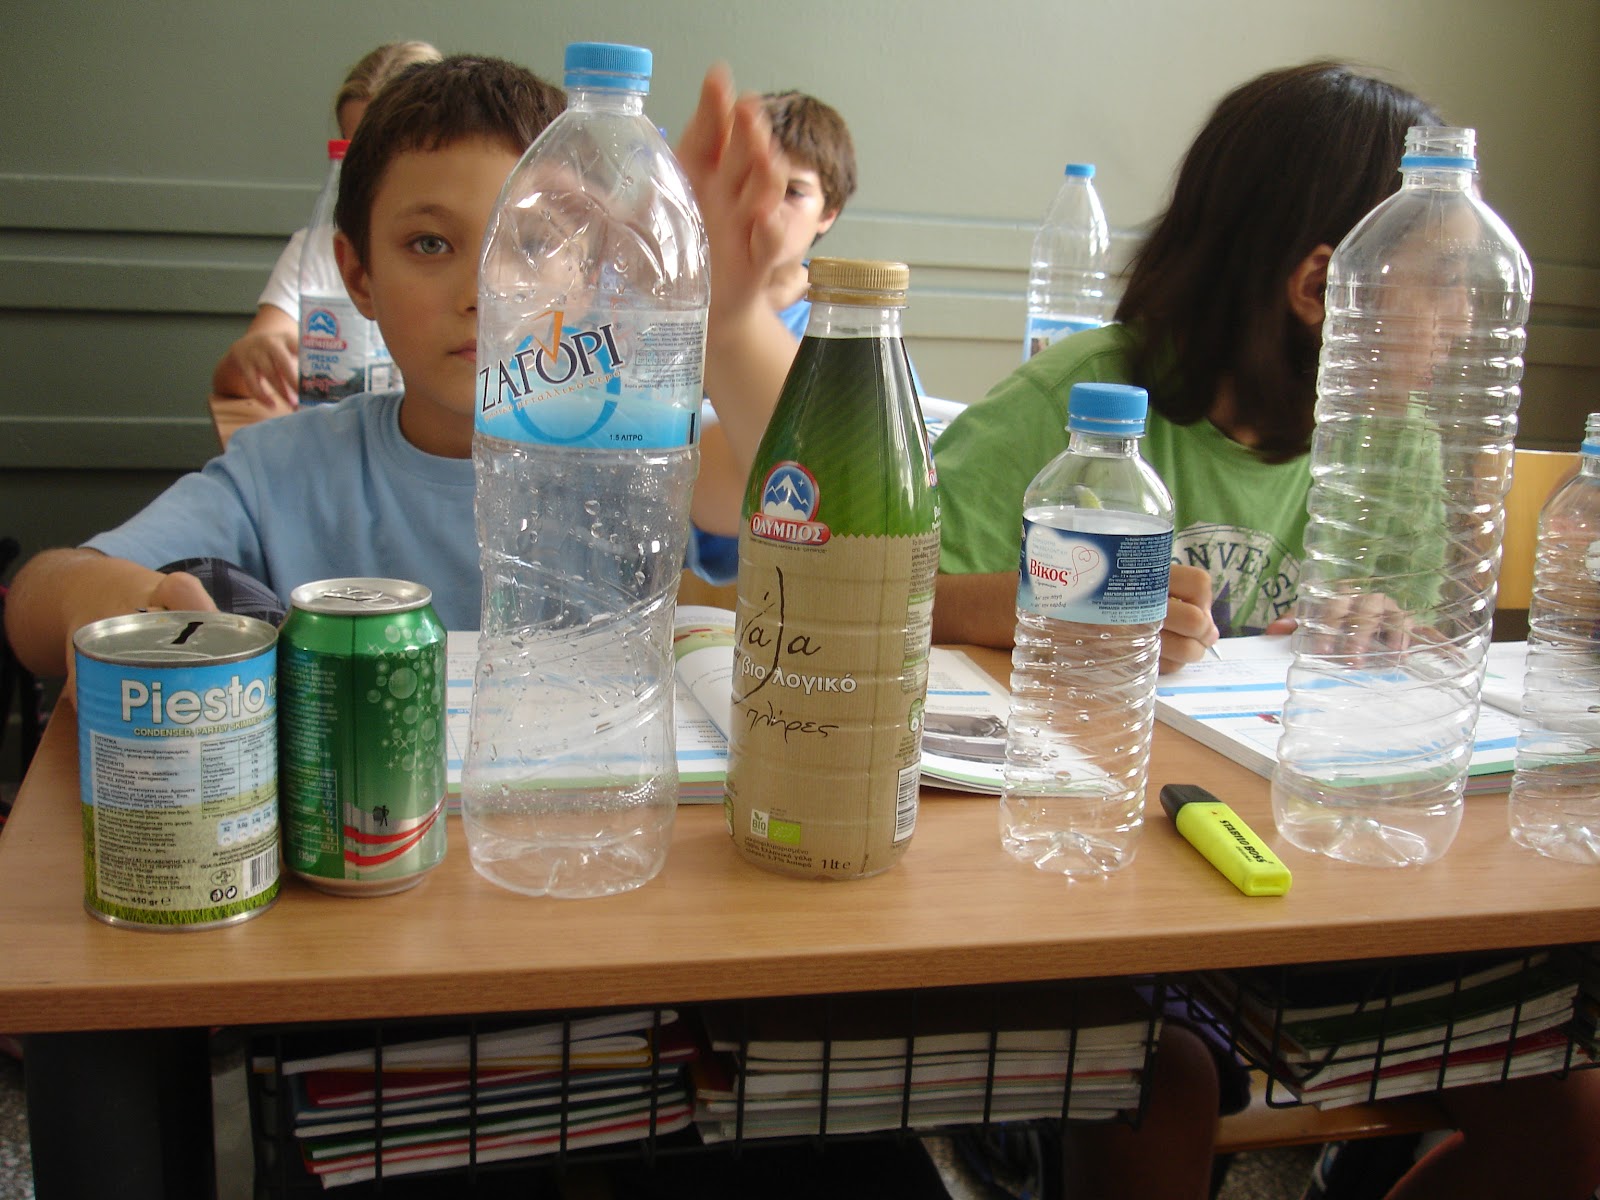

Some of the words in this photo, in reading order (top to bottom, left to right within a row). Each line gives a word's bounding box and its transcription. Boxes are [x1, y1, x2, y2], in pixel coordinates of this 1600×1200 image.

[752, 515, 825, 543] ΟΛΥΜΠΟΣ
[1029, 558, 1068, 587] Βίκος
[120, 674, 266, 725] Piesto
[133, 727, 194, 738] CONDENSED,
